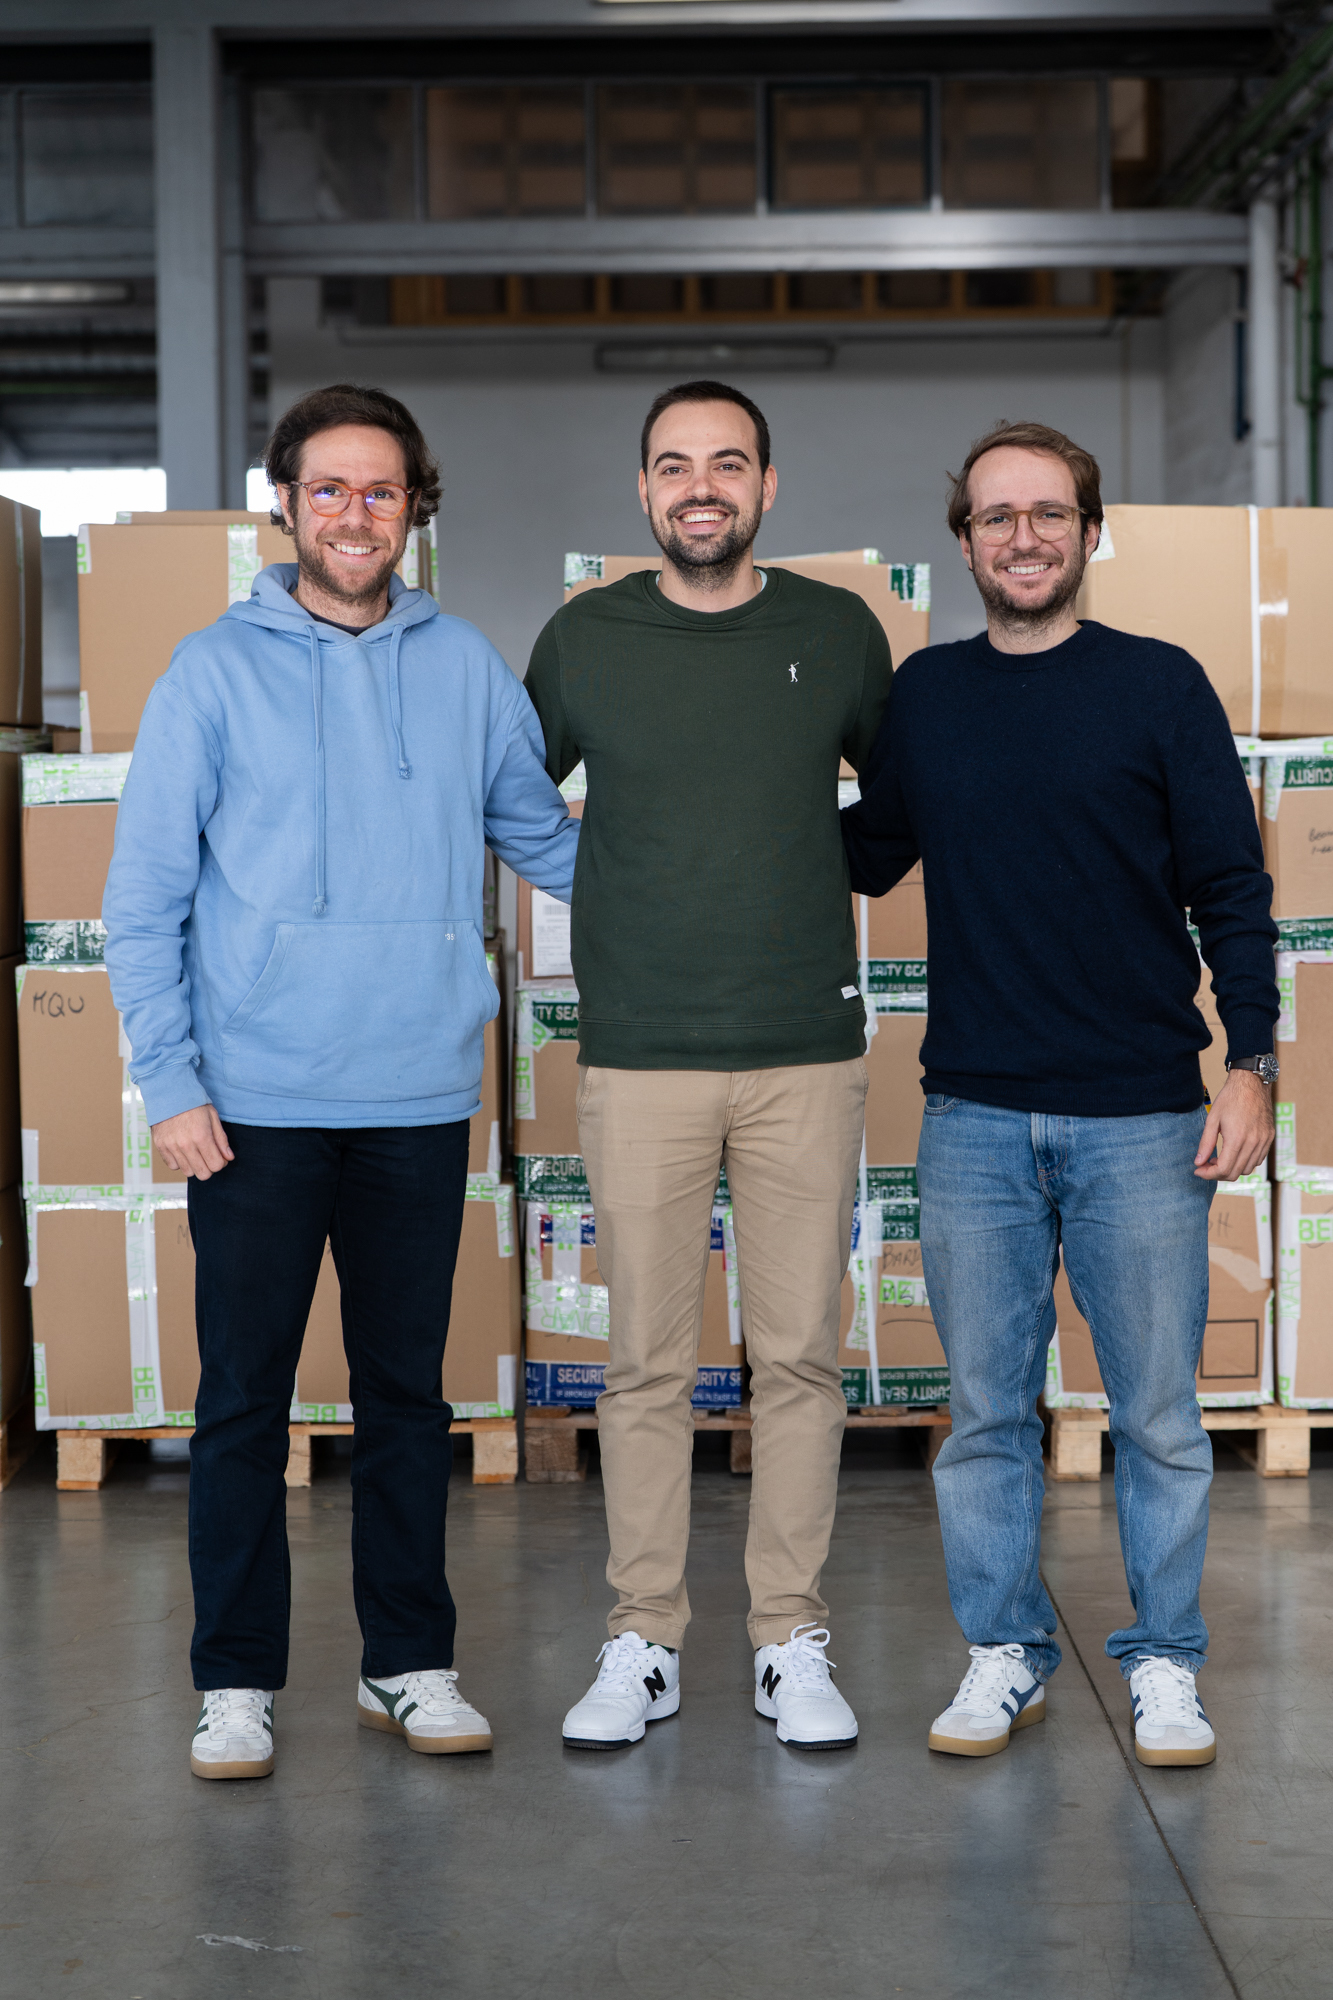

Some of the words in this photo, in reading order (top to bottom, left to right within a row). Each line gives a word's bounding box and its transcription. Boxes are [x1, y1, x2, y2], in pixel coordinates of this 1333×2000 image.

[557, 1367, 604, 1384] SECURI
[643, 1666, 667, 1702] N
[761, 1664, 781, 1700] N
